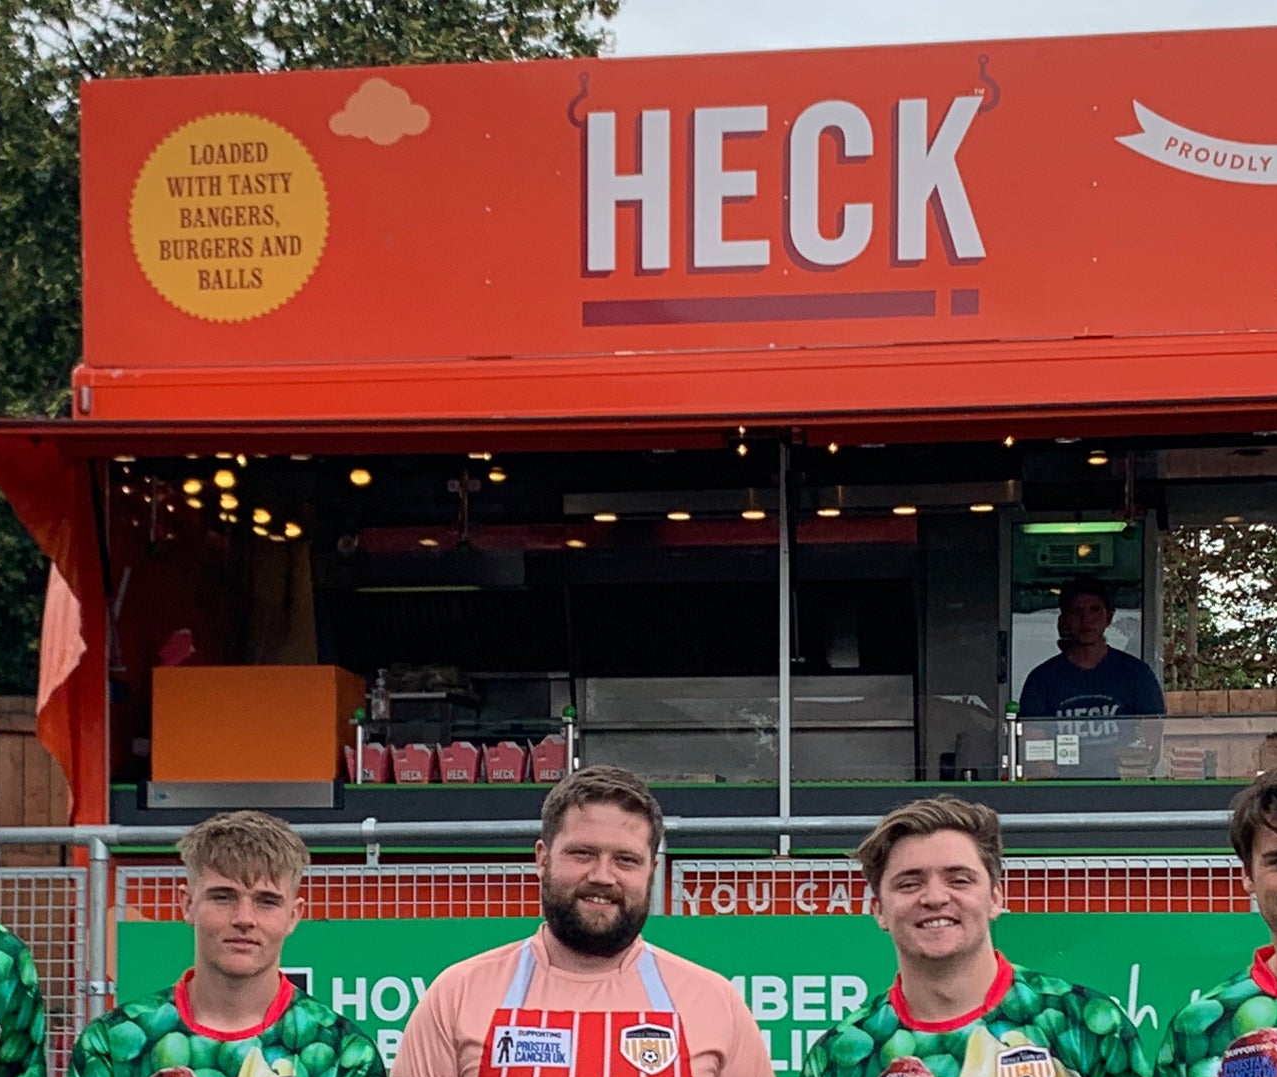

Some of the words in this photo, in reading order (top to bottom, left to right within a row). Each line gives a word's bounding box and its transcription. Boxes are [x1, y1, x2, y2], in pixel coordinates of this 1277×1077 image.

[189, 142, 269, 167] LOADED
[1164, 135, 1273, 174] PROUDLY
[166, 174, 222, 198] WITH
[227, 171, 293, 196] TASTY
[586, 95, 987, 273] HECK
[179, 204, 281, 230] BANGERS,
[158, 235, 254, 261] BURGERS
[260, 233, 303, 257] AND
[197, 267, 264, 292] BALLS
[492, 769, 515, 780] HECK
[681, 882, 771, 916] YOU
[515, 1040, 562, 1053] PROSTATE
[517, 1029, 562, 1039] SUPPORTING
[514, 1051, 552, 1063] CANCER
[552, 1052, 566, 1064] UK
